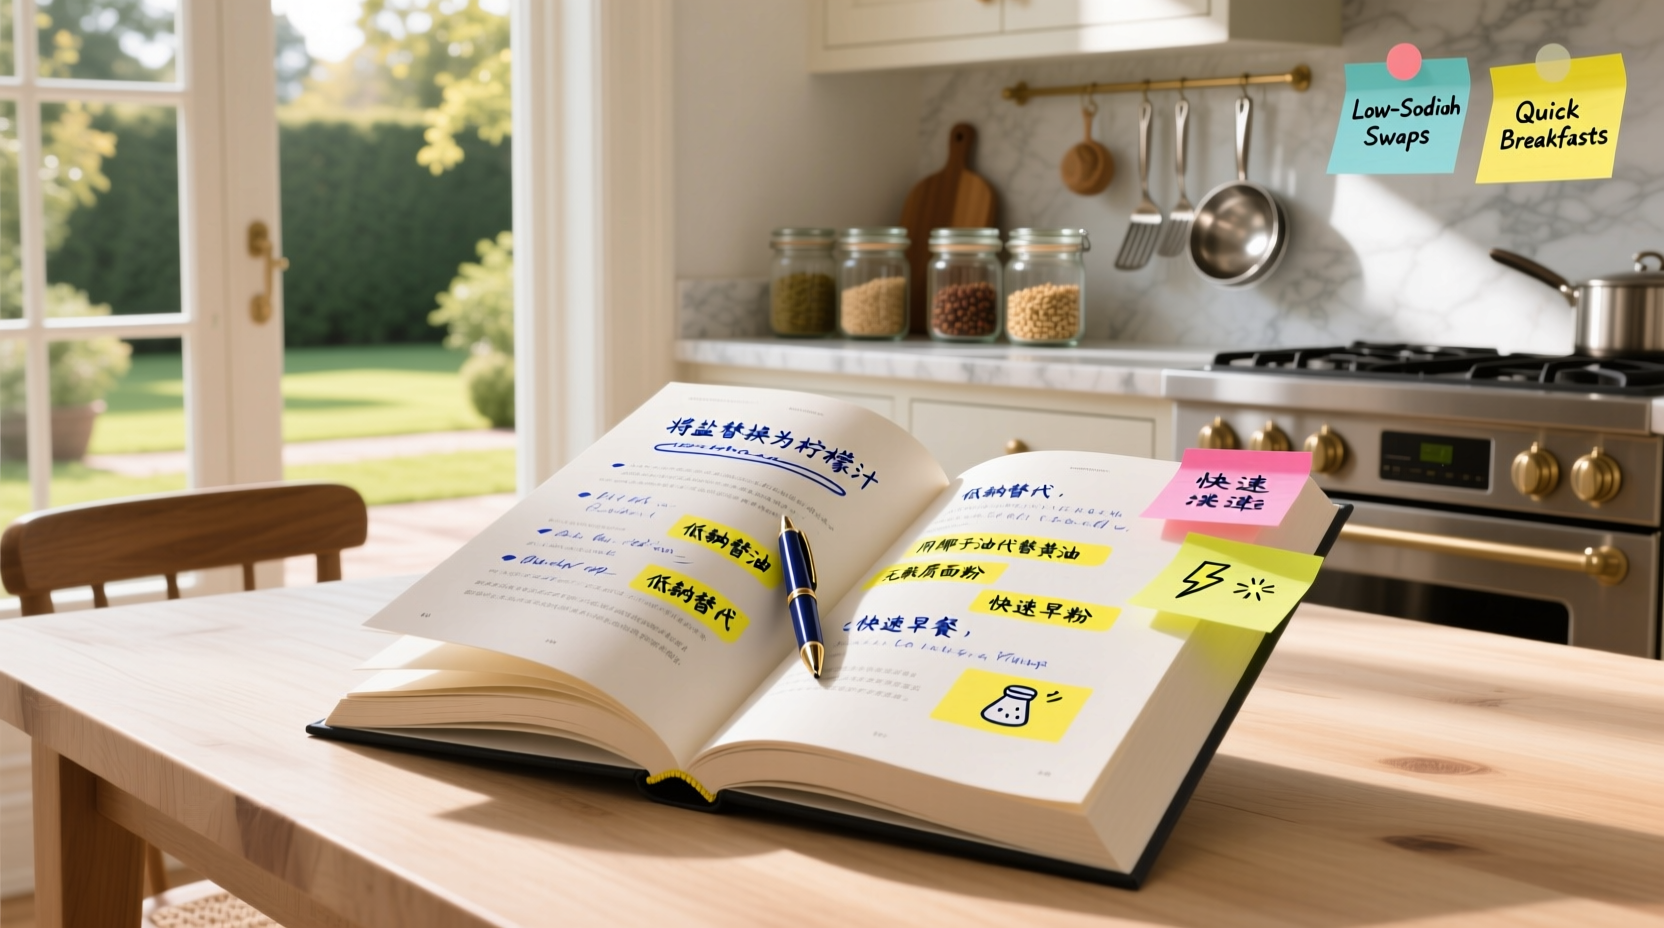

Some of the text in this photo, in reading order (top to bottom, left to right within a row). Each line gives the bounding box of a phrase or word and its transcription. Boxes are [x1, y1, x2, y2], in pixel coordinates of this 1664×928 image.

[1515, 97, 1580, 124] Quick
[1363, 125, 1430, 153] Swaps
[1500, 121, 1608, 150] Breakfasts
[1195, 471, 1269, 494] 快速
[988, 594, 1093, 624] 快速早粉
